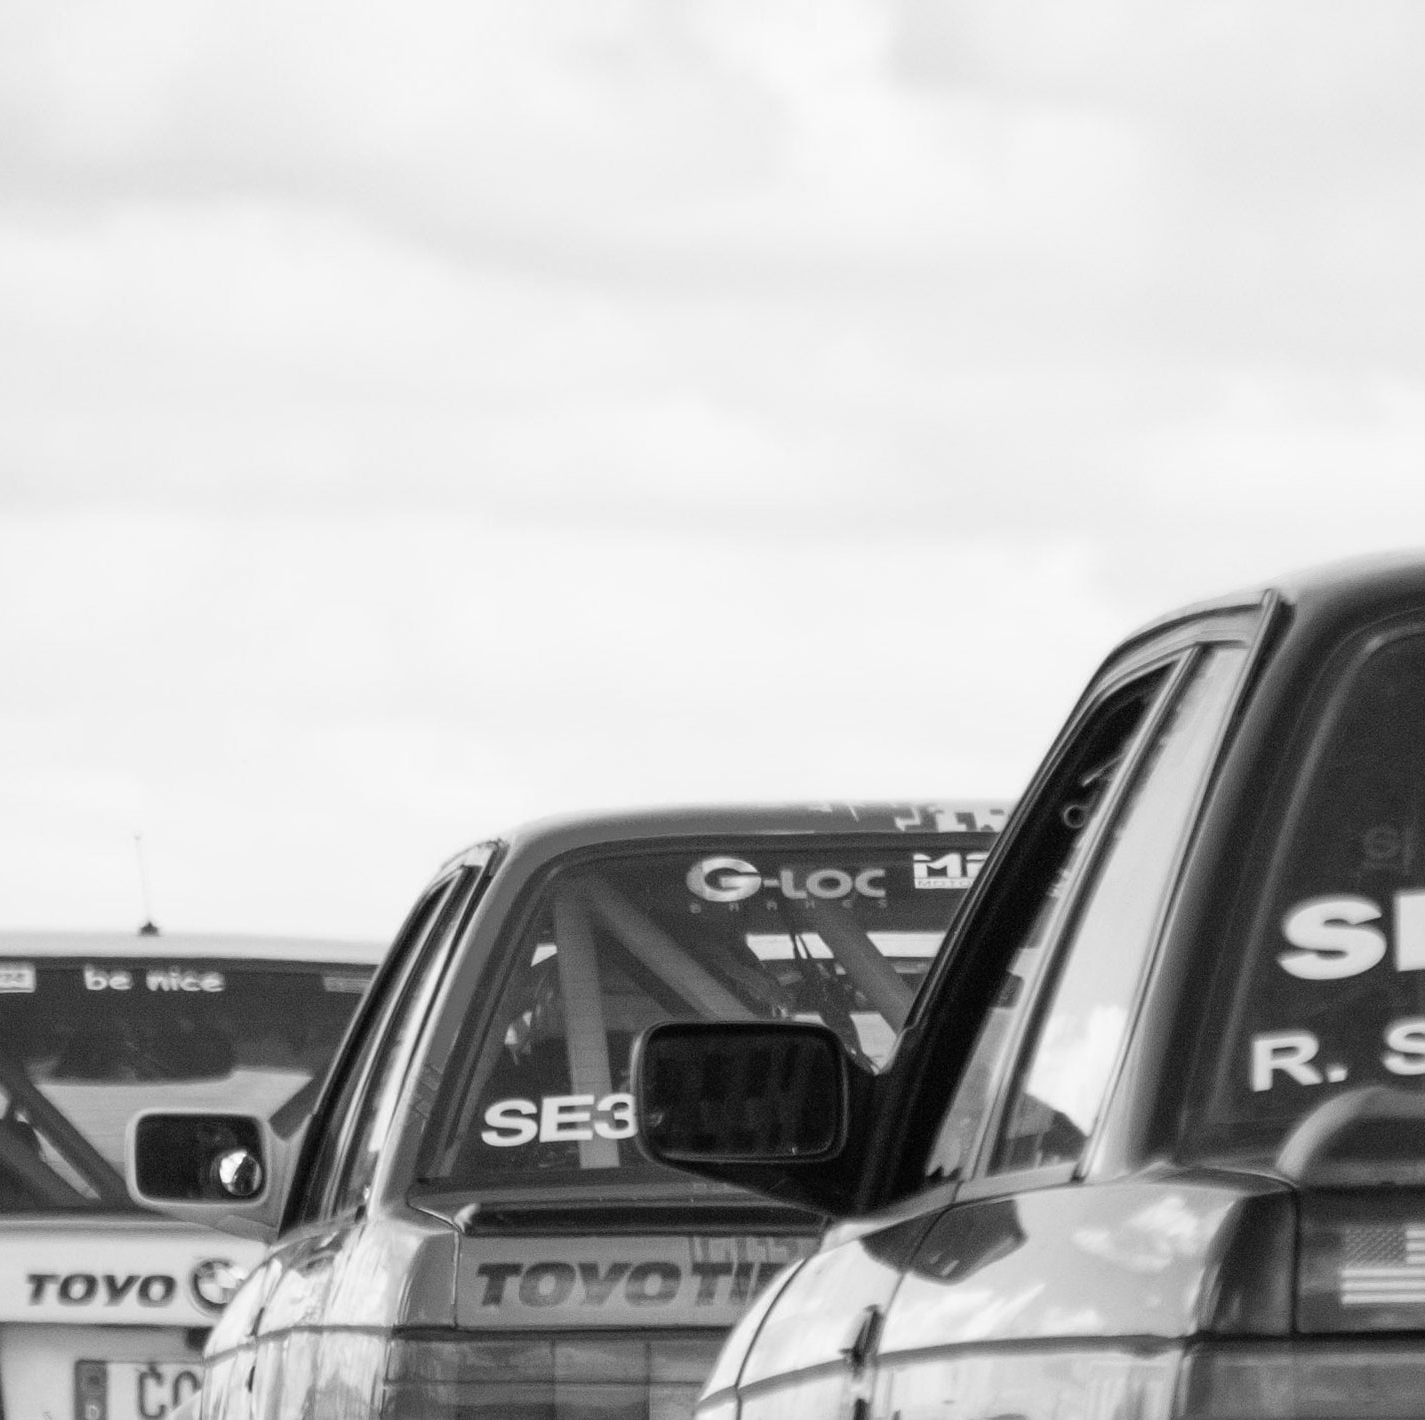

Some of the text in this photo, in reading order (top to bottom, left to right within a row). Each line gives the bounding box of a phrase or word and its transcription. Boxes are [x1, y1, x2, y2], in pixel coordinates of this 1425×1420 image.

[686, 857, 887, 902] G-LOC
[84, 965, 225, 992] be nice
[1250, 1031, 1348, 1091] R.
[26, 1273, 175, 1307] TOYO
[477, 1261, 682, 1308] TOYO
